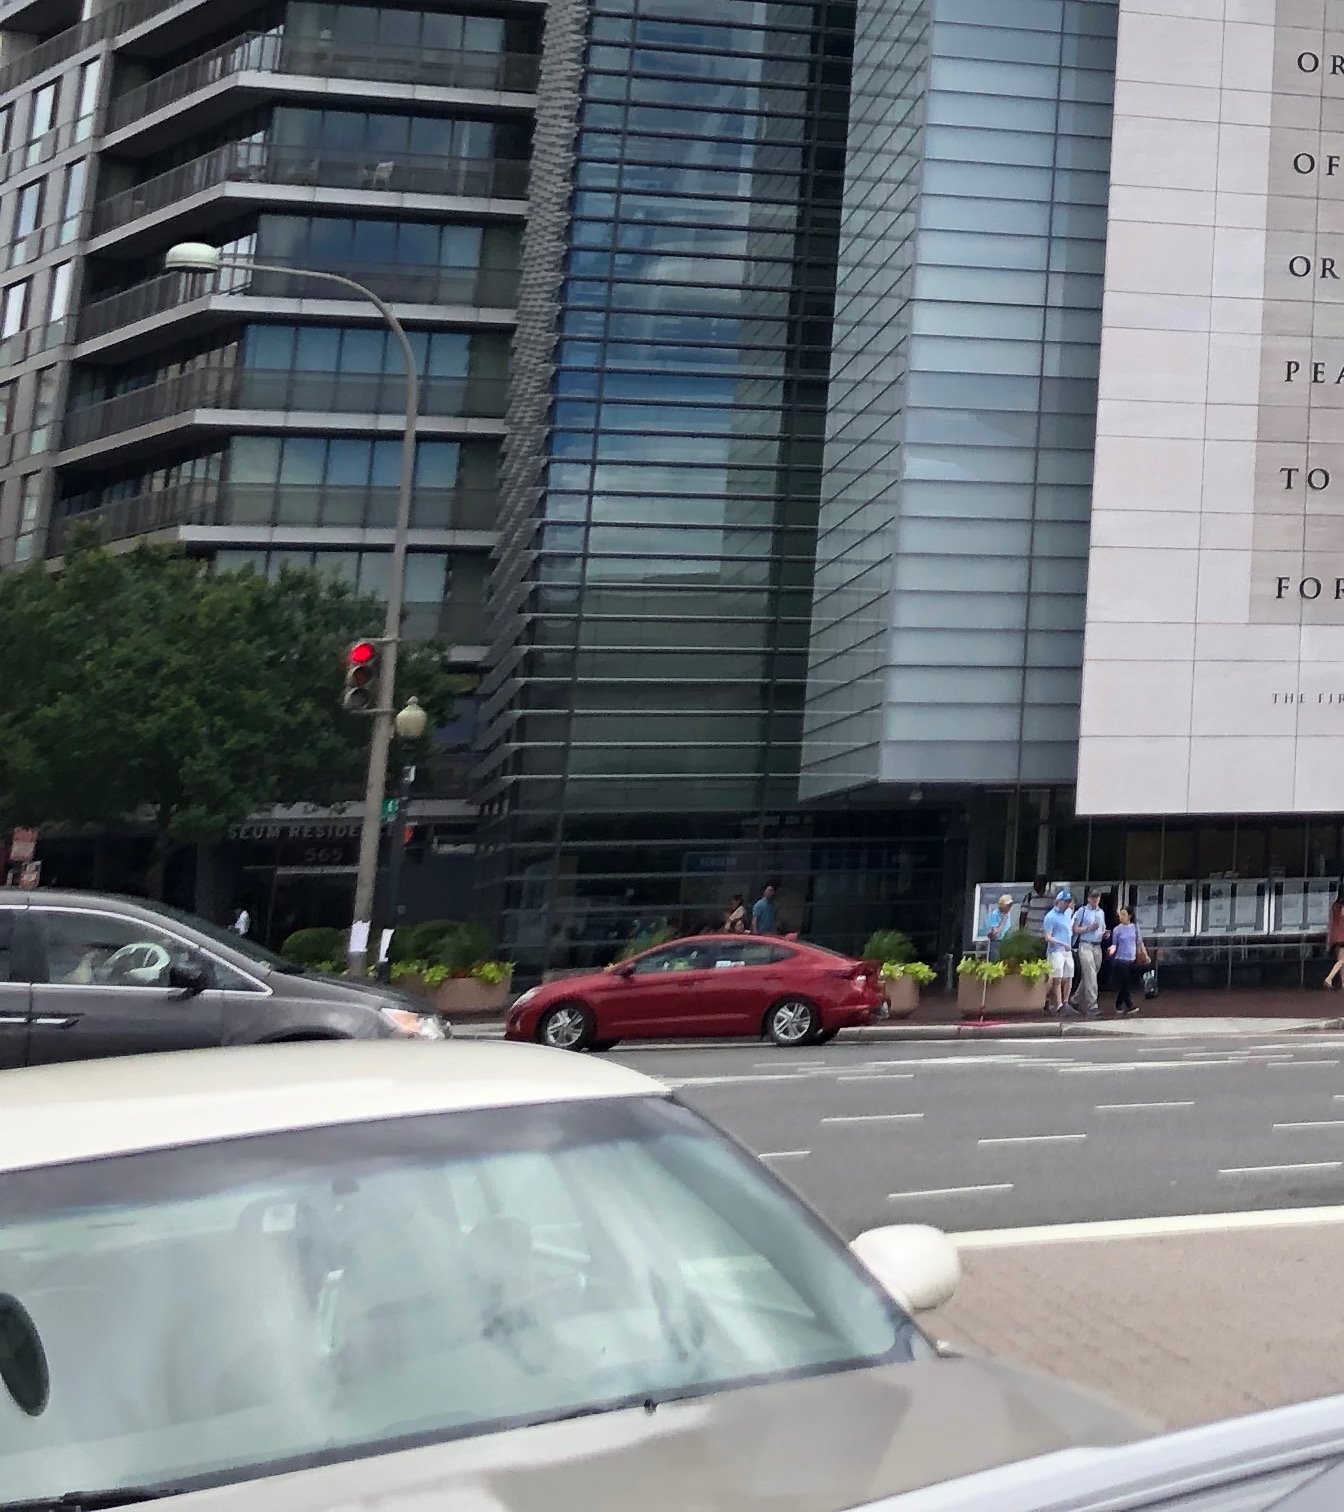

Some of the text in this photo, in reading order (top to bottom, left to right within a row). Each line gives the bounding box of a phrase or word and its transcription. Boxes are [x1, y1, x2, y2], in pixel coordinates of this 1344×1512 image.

[1292, 152, 1341, 177] OF
[1288, 255, 1341, 280] OR
[1279, 467, 1330, 491] TO
[1273, 692, 1304, 705] THE
